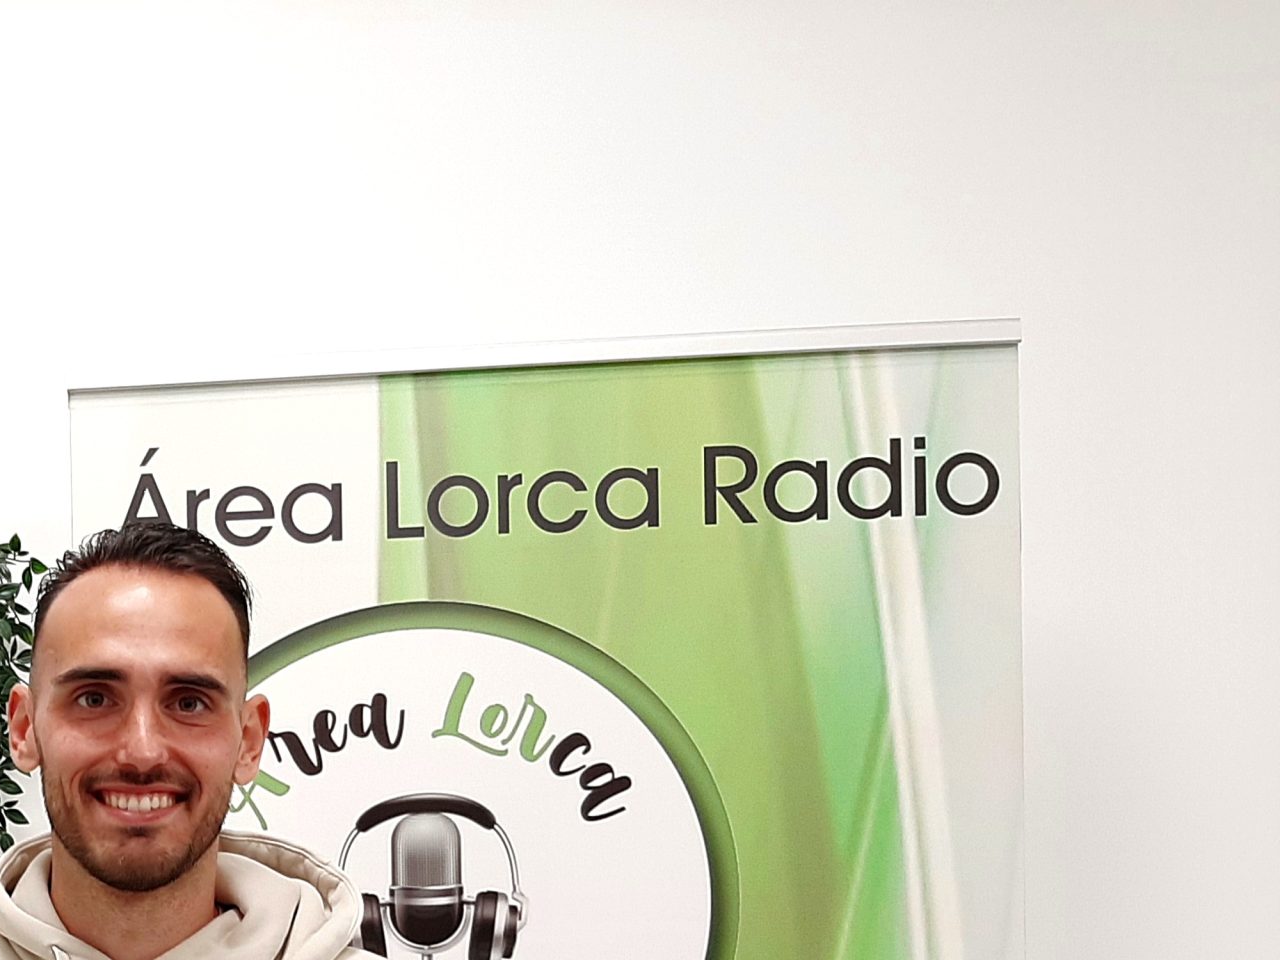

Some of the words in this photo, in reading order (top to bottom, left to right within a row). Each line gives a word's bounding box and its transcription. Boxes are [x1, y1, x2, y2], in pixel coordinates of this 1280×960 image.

[121, 447, 343, 547] Área
[385, 460, 660, 540] Lorca
[702, 436, 1001, 527] Radio
[431, 672, 632, 821] Lorca
